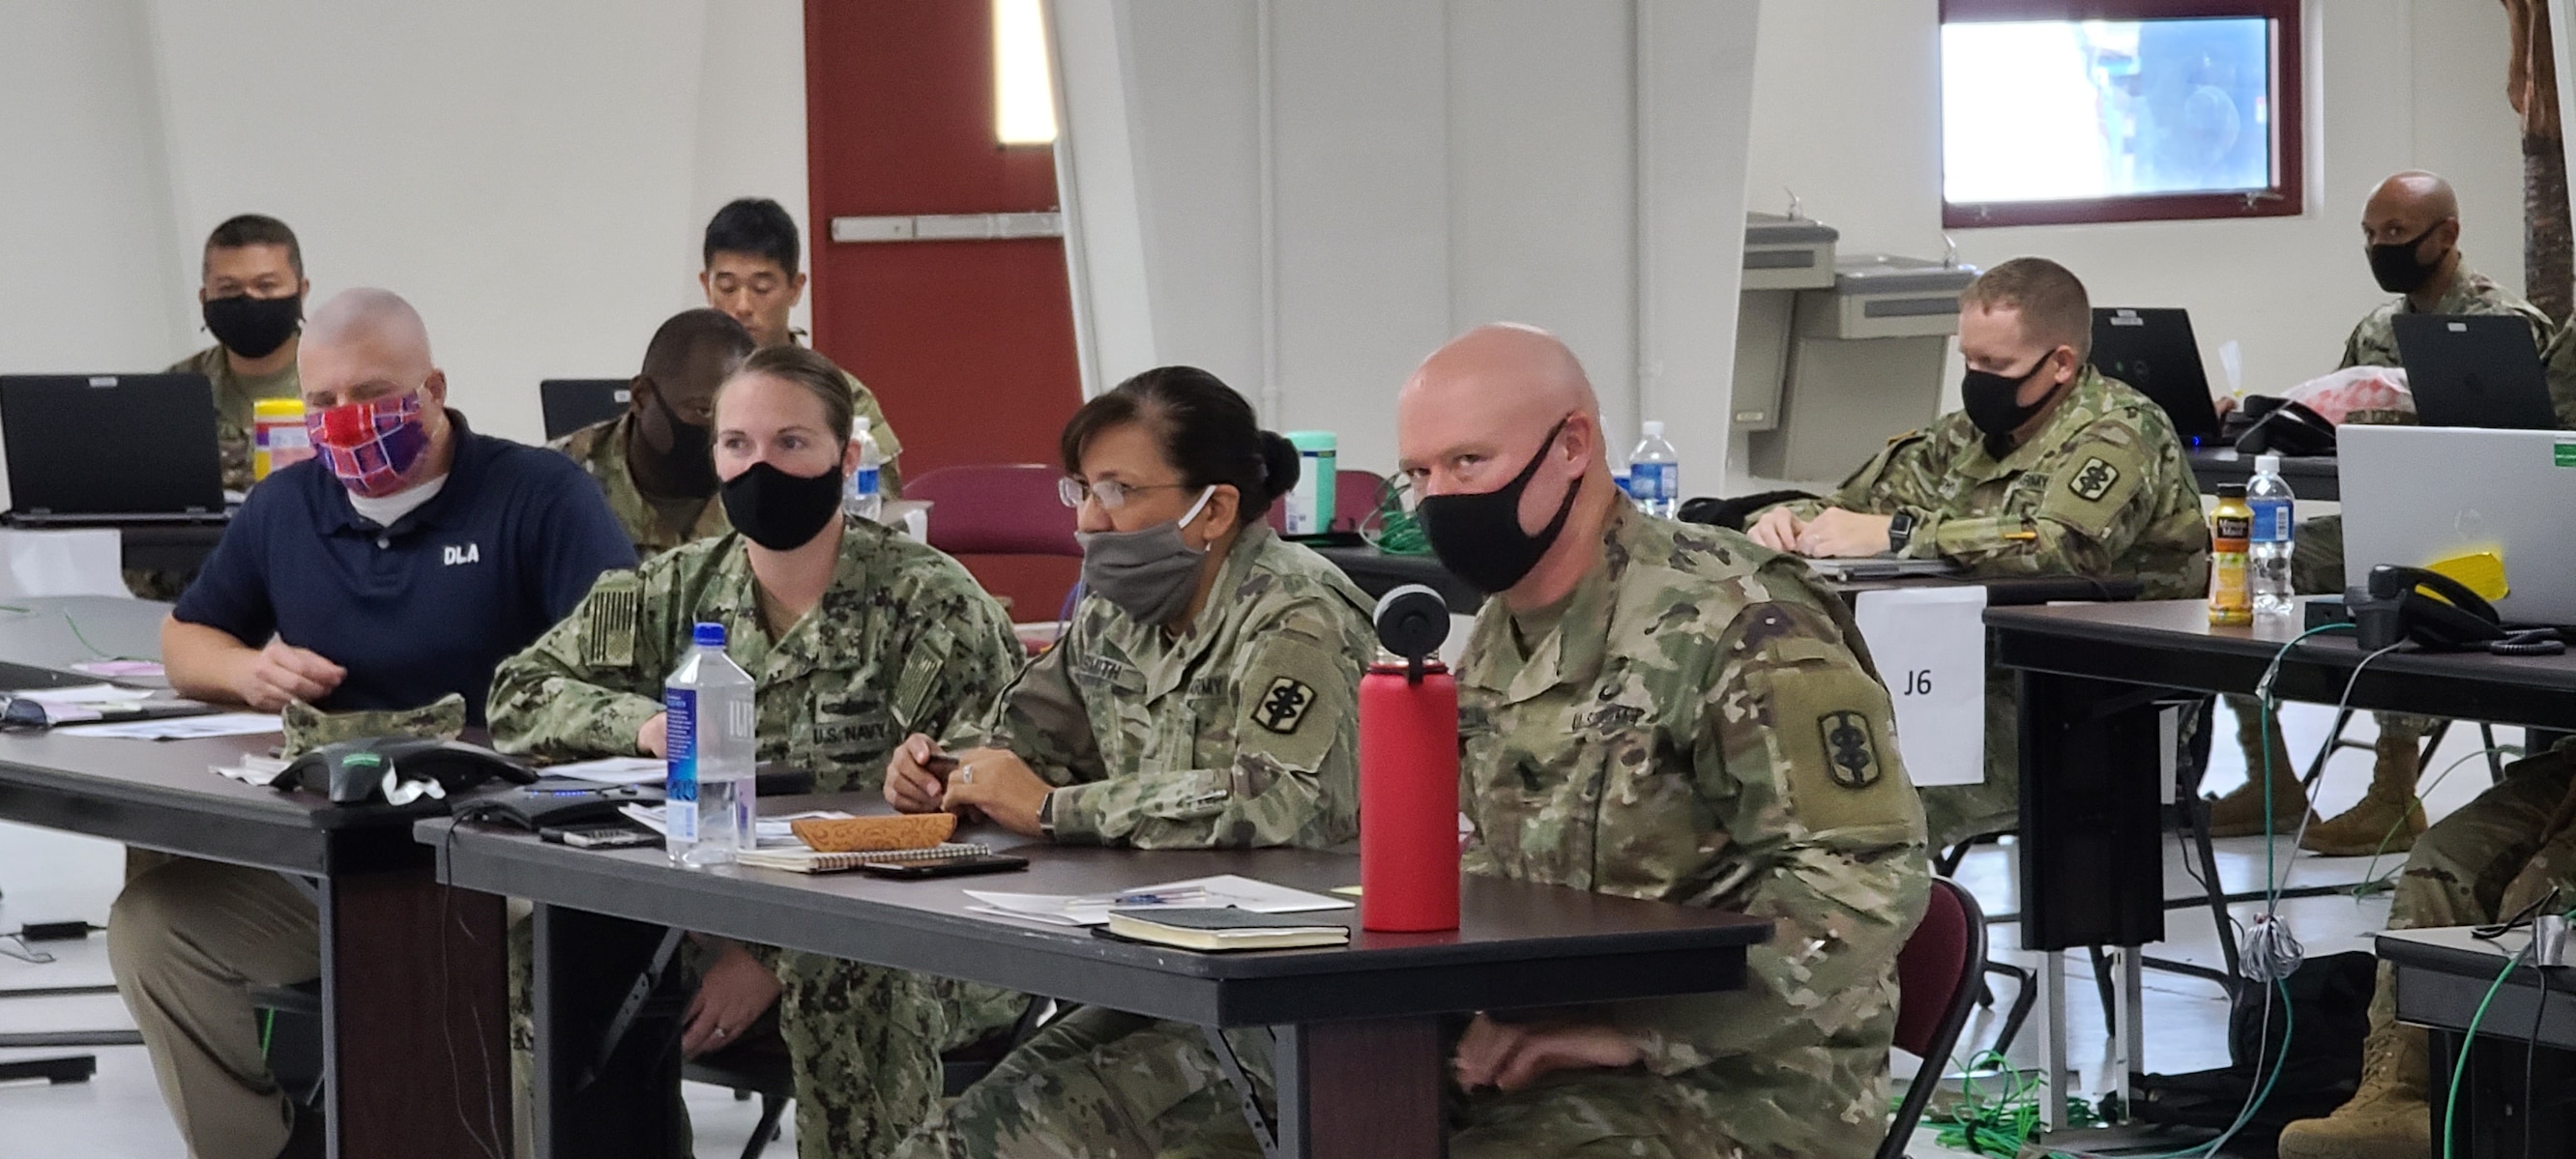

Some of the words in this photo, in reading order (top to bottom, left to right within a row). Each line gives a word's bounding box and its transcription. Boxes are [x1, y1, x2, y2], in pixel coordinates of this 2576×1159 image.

[444, 543, 480, 565] DLA
[1082, 655, 1122, 681] SMITH
[1904, 669, 1932, 696] J6
[844, 722, 886, 743] NAVY
